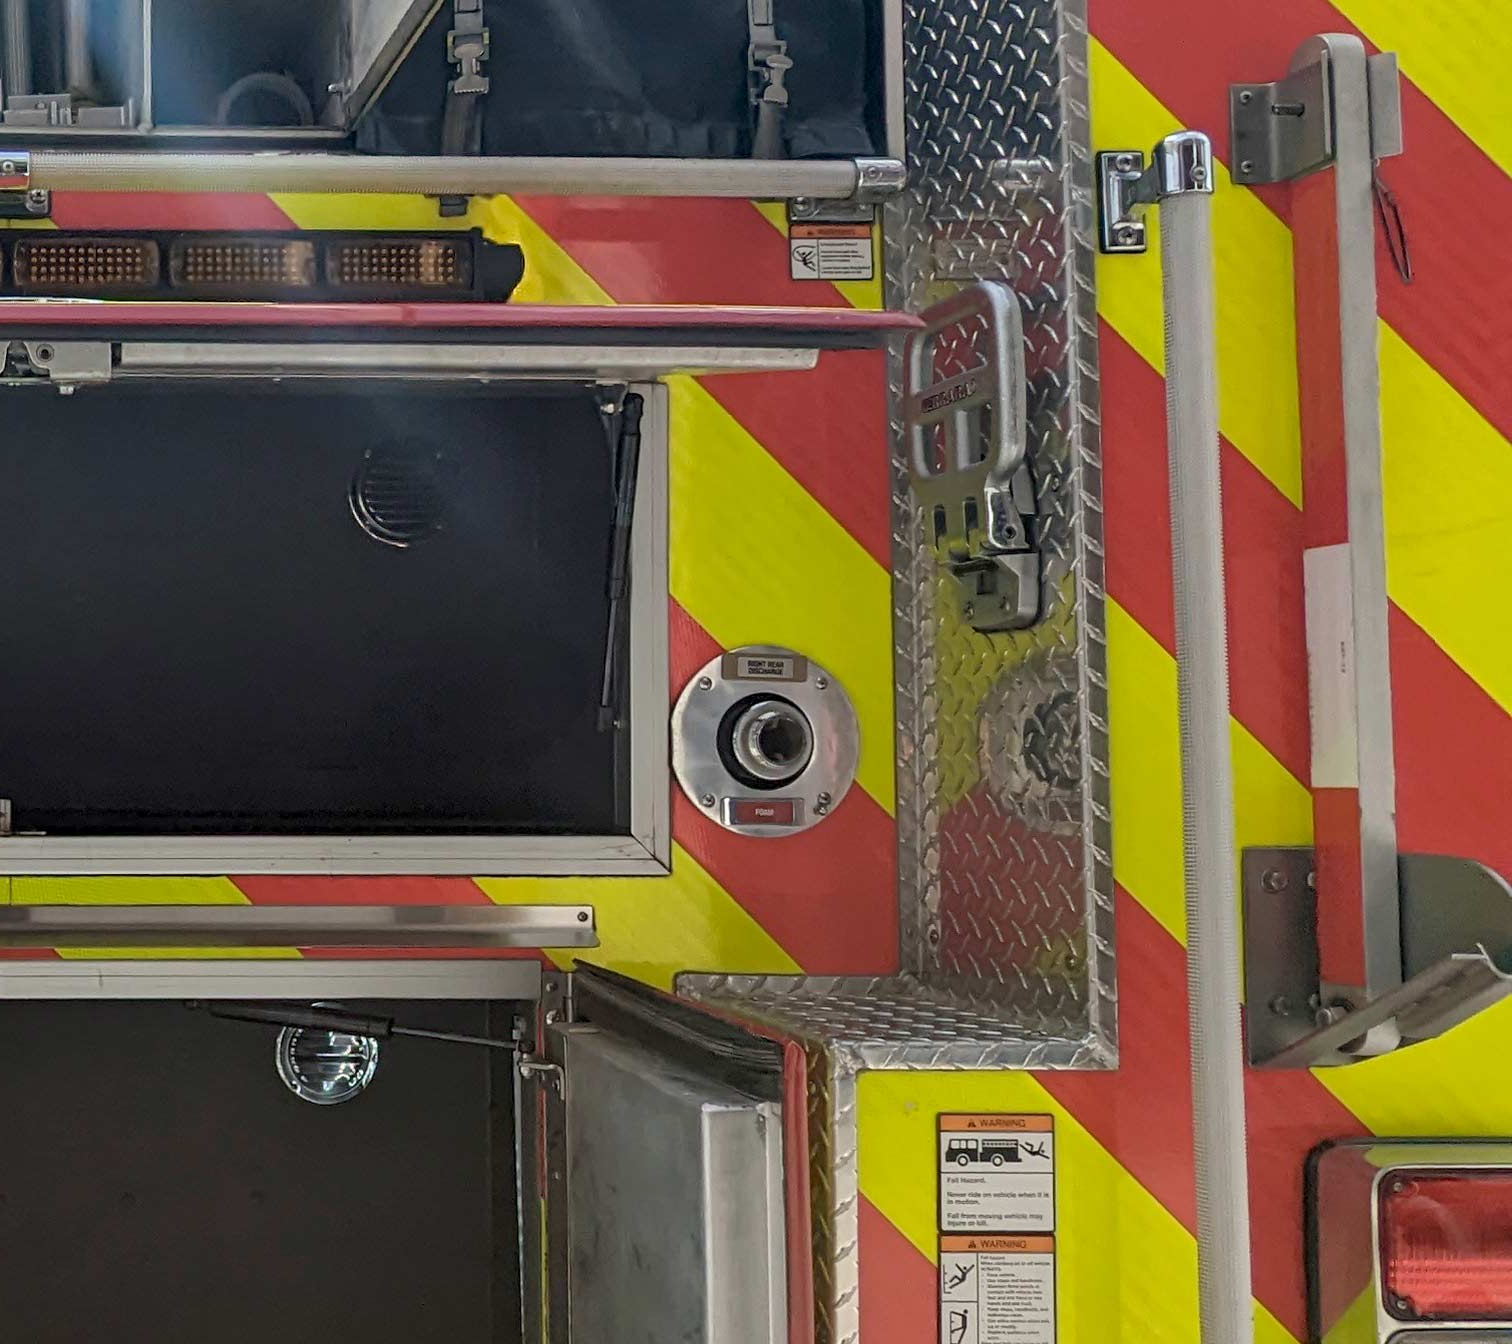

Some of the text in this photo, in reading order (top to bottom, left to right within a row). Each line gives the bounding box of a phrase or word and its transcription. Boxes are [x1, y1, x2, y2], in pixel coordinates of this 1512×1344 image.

[748, 667, 784, 675] DISCHARGE
[979, 1119, 1026, 1127] WARNING
[980, 1239, 1027, 1248] WARNING
